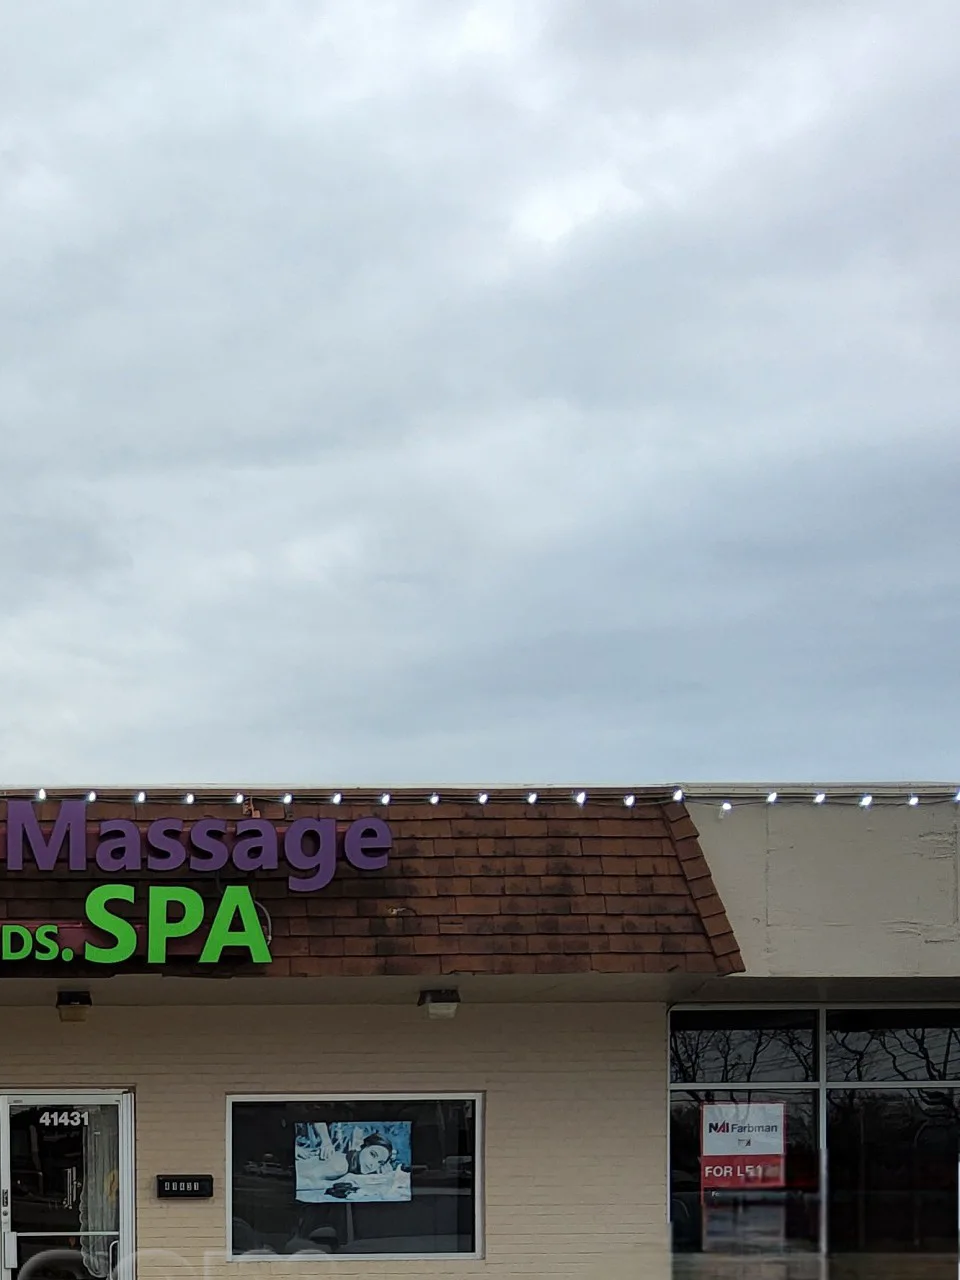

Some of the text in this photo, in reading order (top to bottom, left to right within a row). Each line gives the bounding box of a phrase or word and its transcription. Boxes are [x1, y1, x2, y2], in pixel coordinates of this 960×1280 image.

[6, 800, 393, 892] Massage
[83, 884, 272, 963] SPA
[39, 1111, 89, 1126] 41431
[708, 1121, 778, 1133] NAI Farbman
[704, 1165, 733, 1177] FOR
